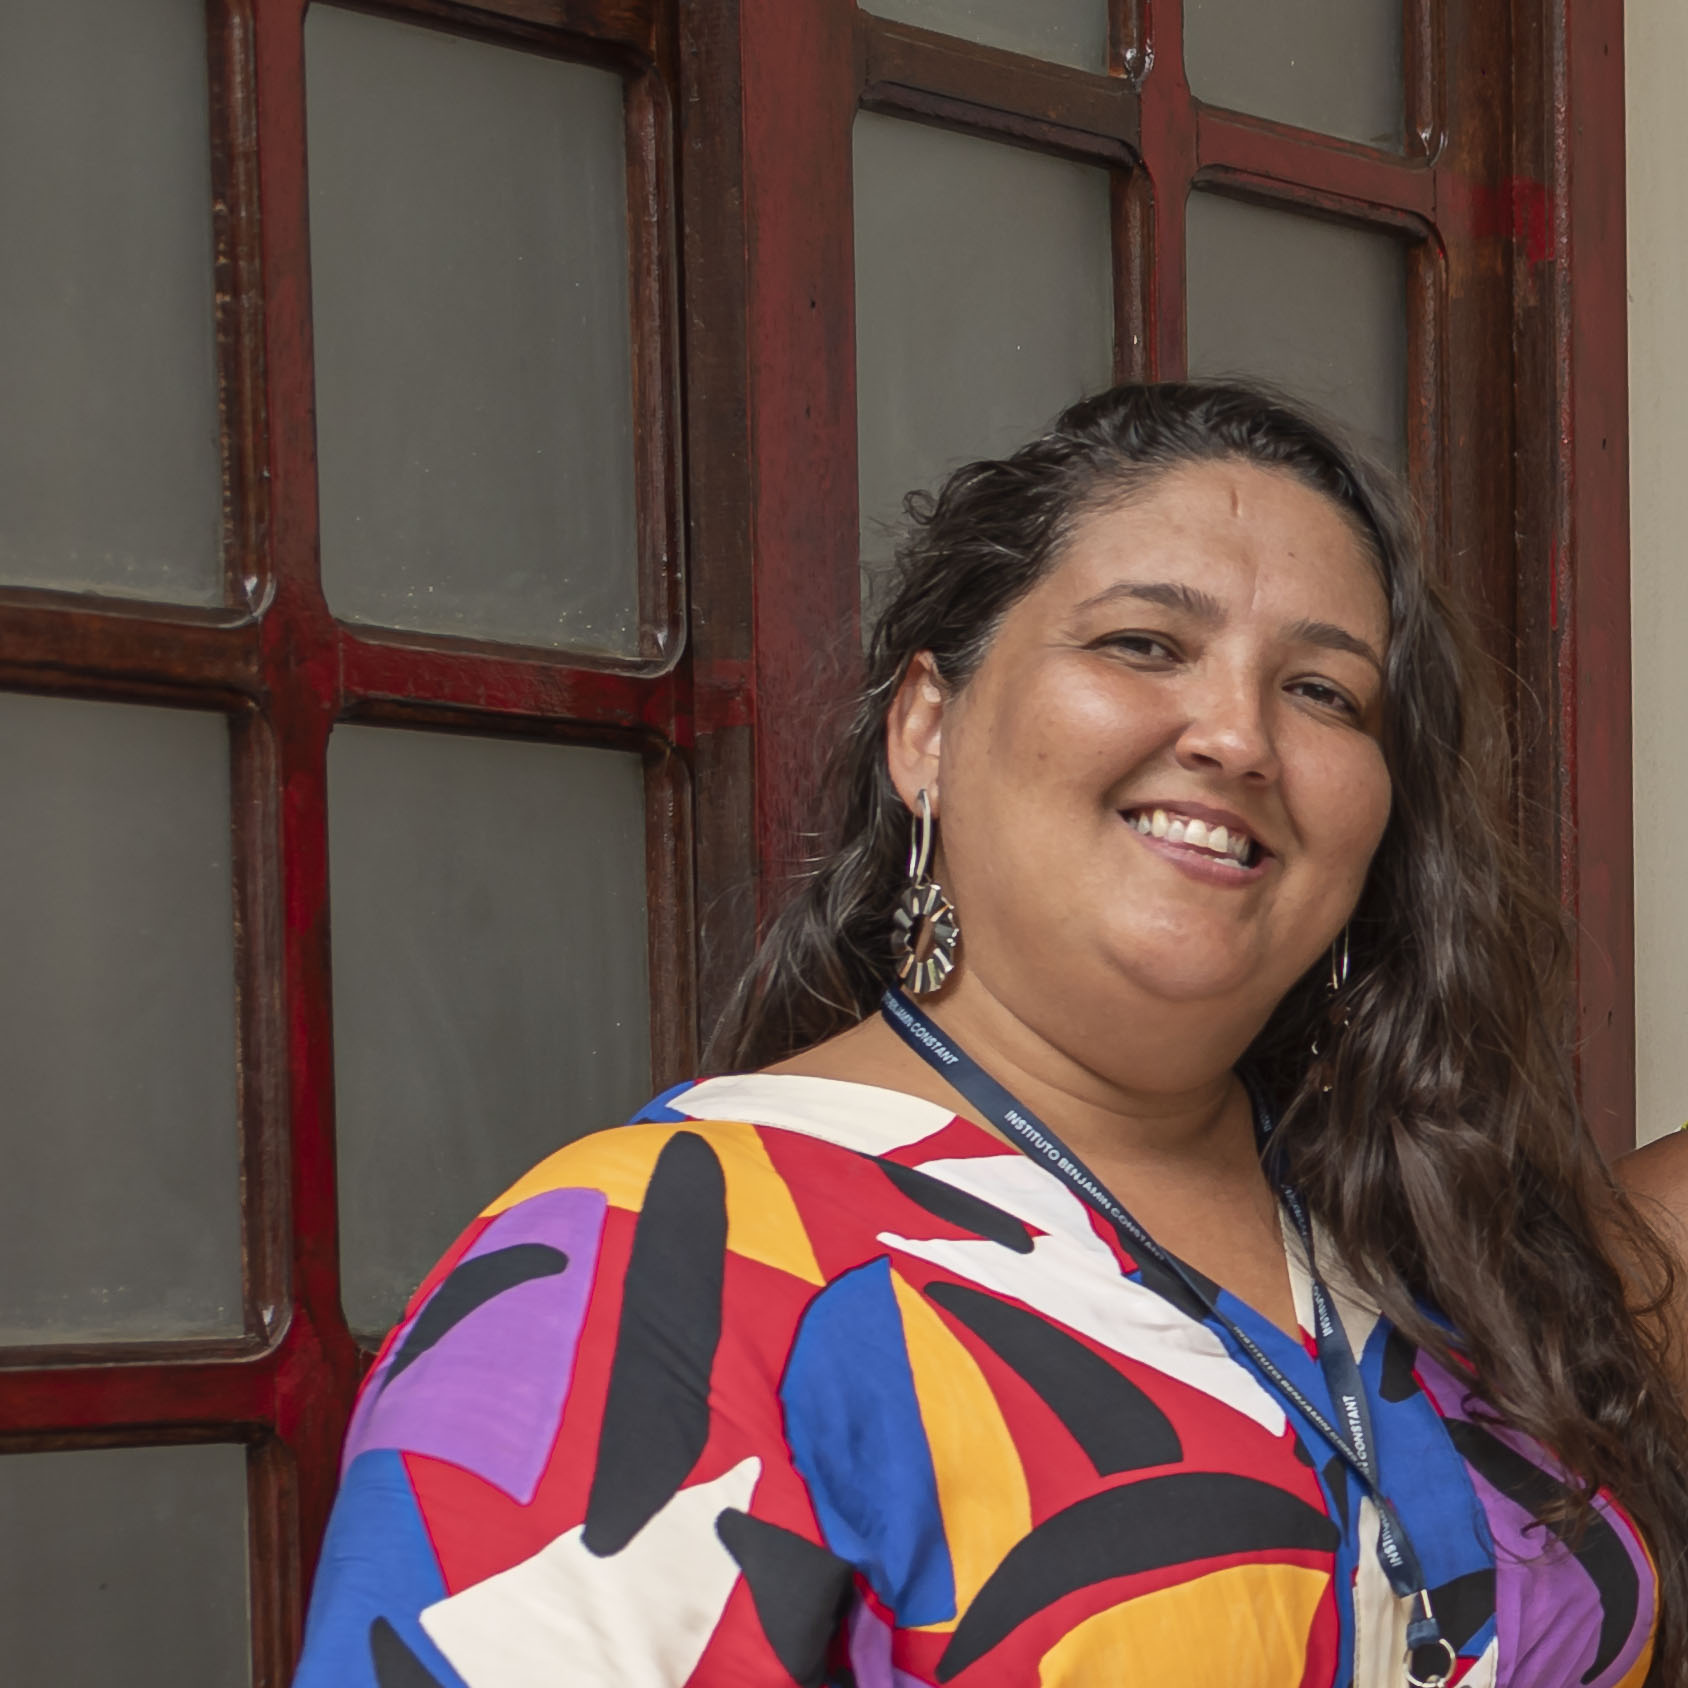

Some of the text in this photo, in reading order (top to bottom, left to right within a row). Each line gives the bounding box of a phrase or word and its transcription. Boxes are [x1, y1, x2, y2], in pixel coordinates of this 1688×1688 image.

[910, 1022, 960, 1065] CONSTANT
[1003, 1109, 1113, 1210] INSTITUTO BENJAMIN
[1342, 1395, 1369, 1461] CONSTANT
